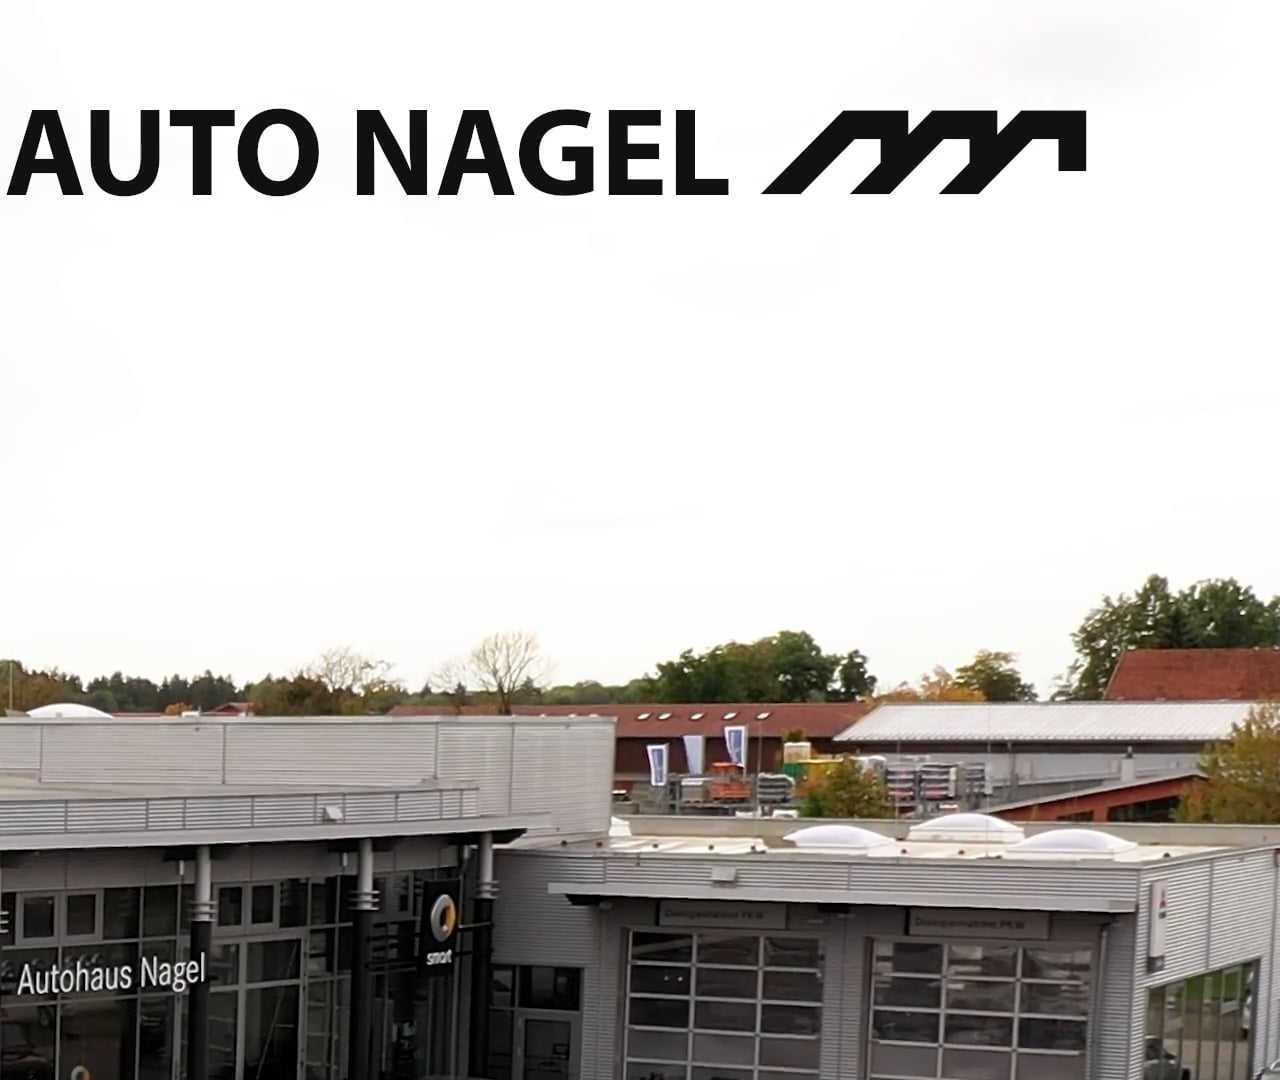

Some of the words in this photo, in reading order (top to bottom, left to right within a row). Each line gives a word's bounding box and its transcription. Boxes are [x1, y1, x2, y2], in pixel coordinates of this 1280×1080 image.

[426, 949, 453, 965] smart
[17, 960, 133, 996] Autohaus
[140, 951, 206, 993] Nagel
